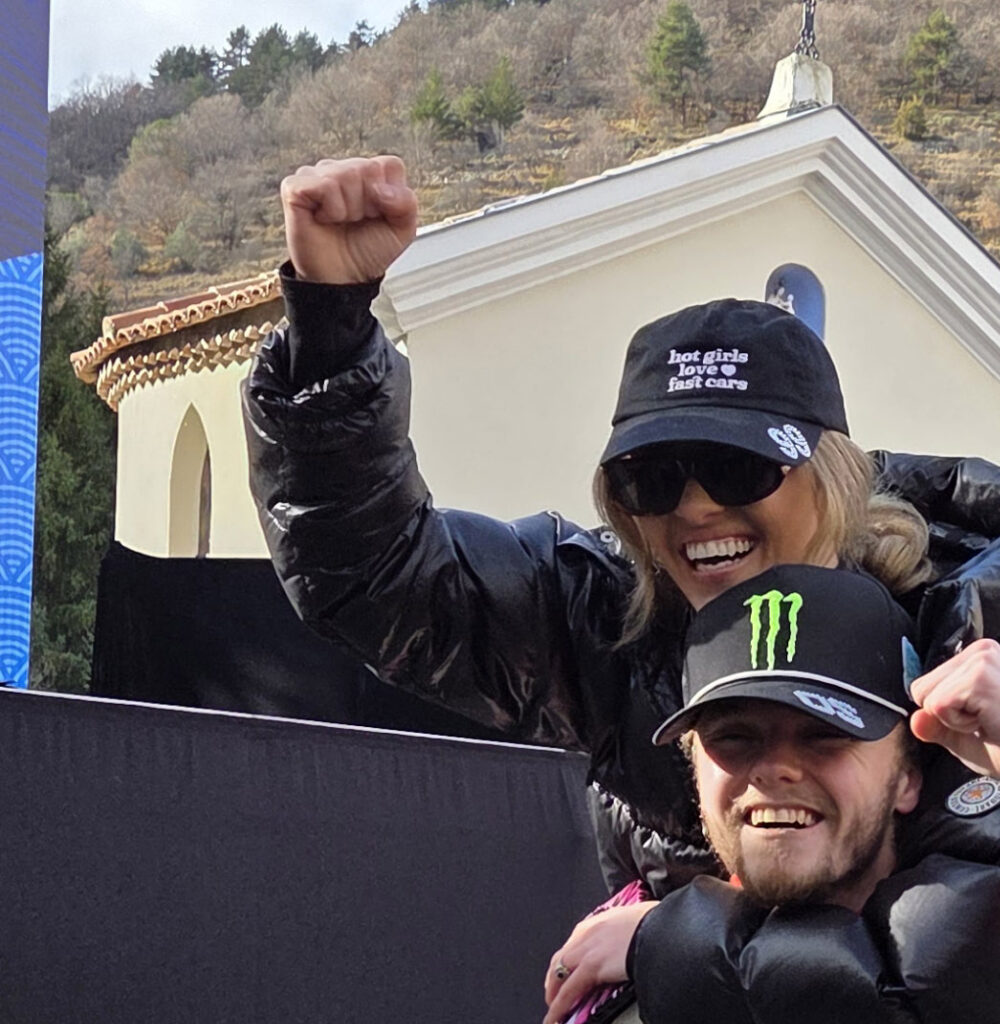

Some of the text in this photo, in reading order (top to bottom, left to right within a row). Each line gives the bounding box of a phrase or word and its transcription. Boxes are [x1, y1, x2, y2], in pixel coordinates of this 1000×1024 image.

[667, 348, 749, 365] hot girls
[678, 363, 719, 377] love
[666, 376, 748, 392] fast cars
